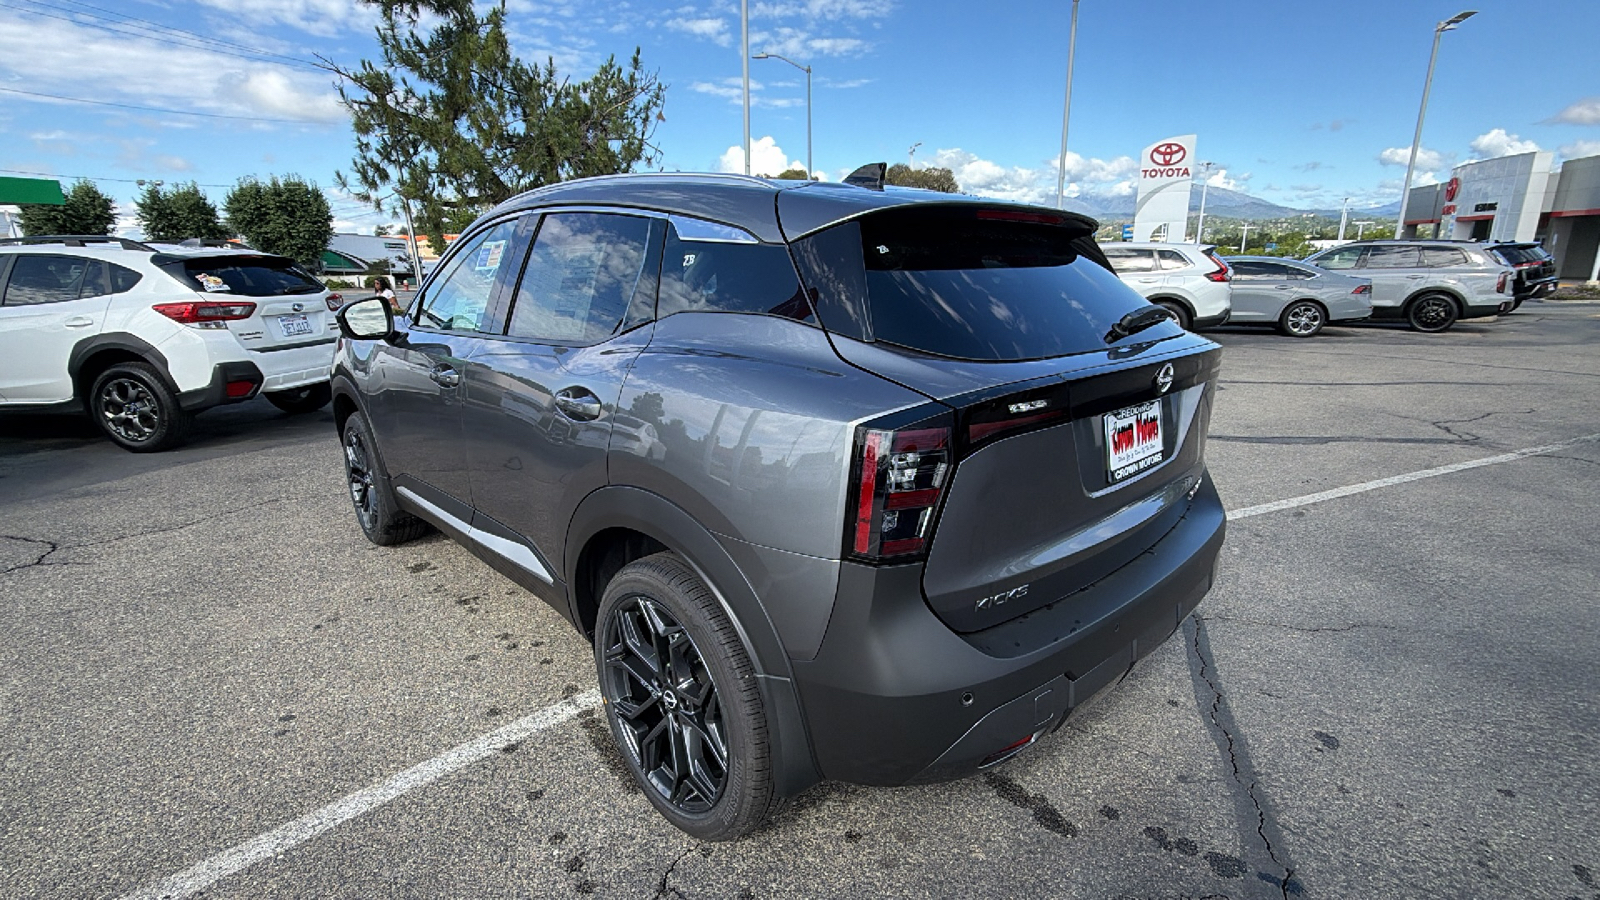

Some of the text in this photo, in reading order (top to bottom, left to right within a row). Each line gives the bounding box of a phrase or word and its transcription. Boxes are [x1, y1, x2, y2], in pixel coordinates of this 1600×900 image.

[1142, 167, 1190, 179] TOYOTA
[1121, 403, 1151, 419] REDDING
[1115, 462, 1139, 480] CROWN
[1139, 452, 1163, 470] MOTORS
[974, 584, 1029, 612] KICKS
